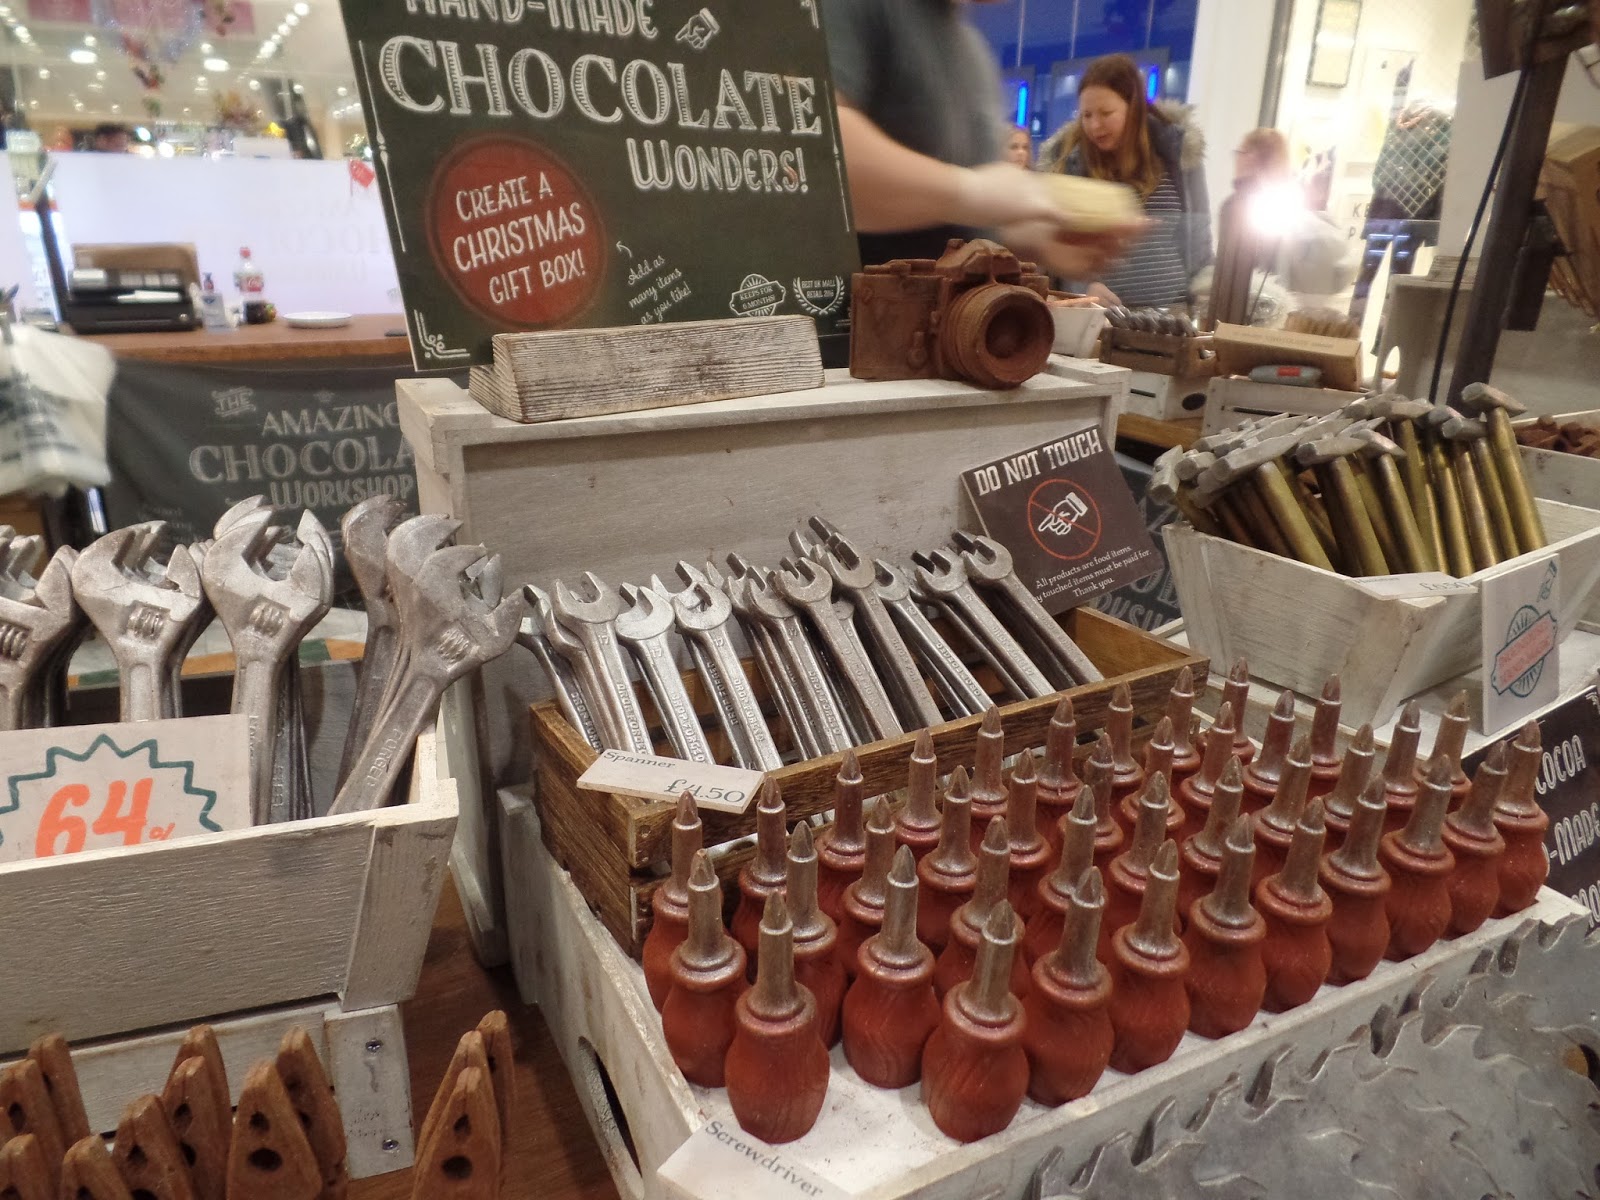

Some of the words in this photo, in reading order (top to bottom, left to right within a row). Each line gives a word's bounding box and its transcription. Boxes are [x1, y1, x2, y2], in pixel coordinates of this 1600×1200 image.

[378, 34, 823, 136] CHOCOLATE
[626, 137, 808, 193] WONDERS!
[456, 176, 533, 221] CREATE
[539, 171, 554, 200] A
[453, 202, 586, 272] CHRISTMAS
[488, 265, 533, 304] GIFT
[539, 248, 586, 289] BOX!
[628, 259, 653, 286] Add
[653, 255, 665, 269] as
[629, 286, 658, 309] many
[656, 268, 682, 289] items
[802, 281, 813, 289] BEST
[814, 280, 821, 288] UK
[822, 279, 836, 287] MALL
[641, 311, 653, 325] as
[653, 300, 672, 322] you
[670, 280, 692, 303] like!
[740, 289, 760, 301] KEEPS
[760, 285, 774, 295] FOR
[807, 290, 823, 298] RETAIL
[218, 395, 250, 410] THE
[974, 465, 1001, 496] DO
[1003, 451, 1041, 485] NOT
[1043, 429, 1103, 470] TOUCH
[270, 474, 414, 510] WORKSHOP
[1036, 576, 1049, 589] All
[1048, 566, 1081, 586] products
[1082, 560, 1094, 570] are
[1094, 551, 1111, 565] food
[1042, 579, 1073, 598] touched
[1072, 573, 1094, 586] items
[1094, 564, 1113, 577] must
[1112, 560, 1123, 569] be
[1123, 551, 1139, 567] paid
[1139, 549, 1152, 559] for.
[1072, 581, 1098, 597] Thank
[603, 751, 675, 769] Spanner
[664, 779, 746, 804] £4.50
[704, 1120, 823, 1196] Screwdriver
